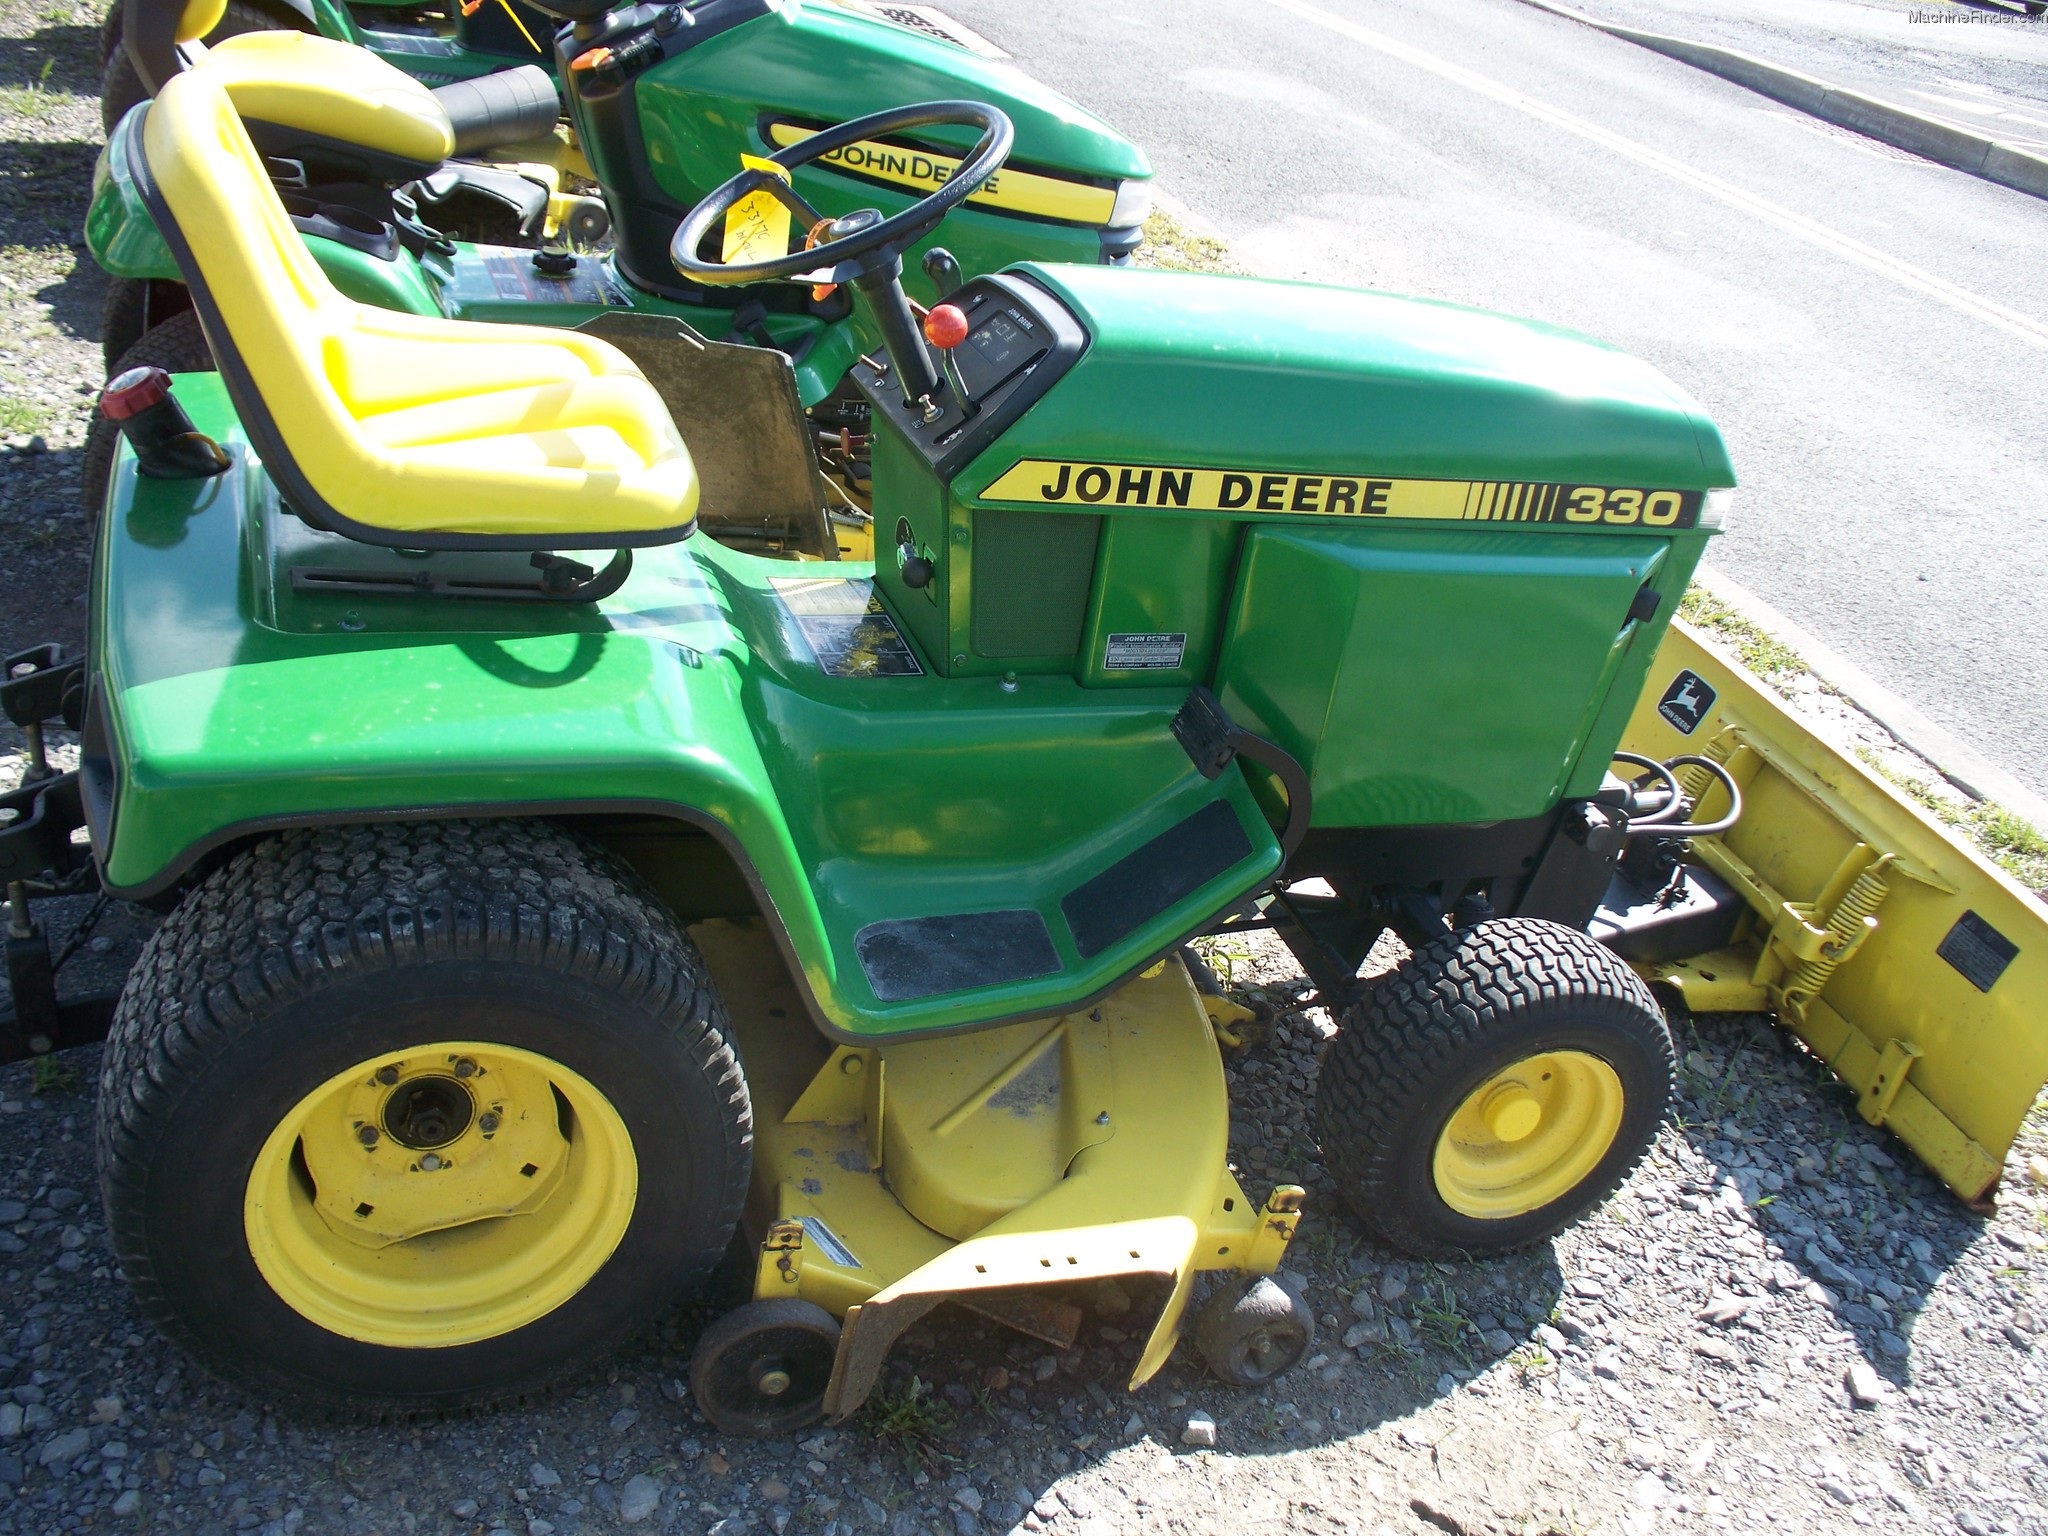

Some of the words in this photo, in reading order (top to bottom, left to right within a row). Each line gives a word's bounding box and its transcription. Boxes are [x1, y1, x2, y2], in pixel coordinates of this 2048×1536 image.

[911, 156, 1000, 194] DEE
[1041, 465, 1193, 507] JOHN
[1217, 474, 1392, 516] DEERE
[1564, 487, 1682, 526] 330
[1659, 704, 1675, 719] JOHN
[1673, 714, 1691, 732] DEERE
